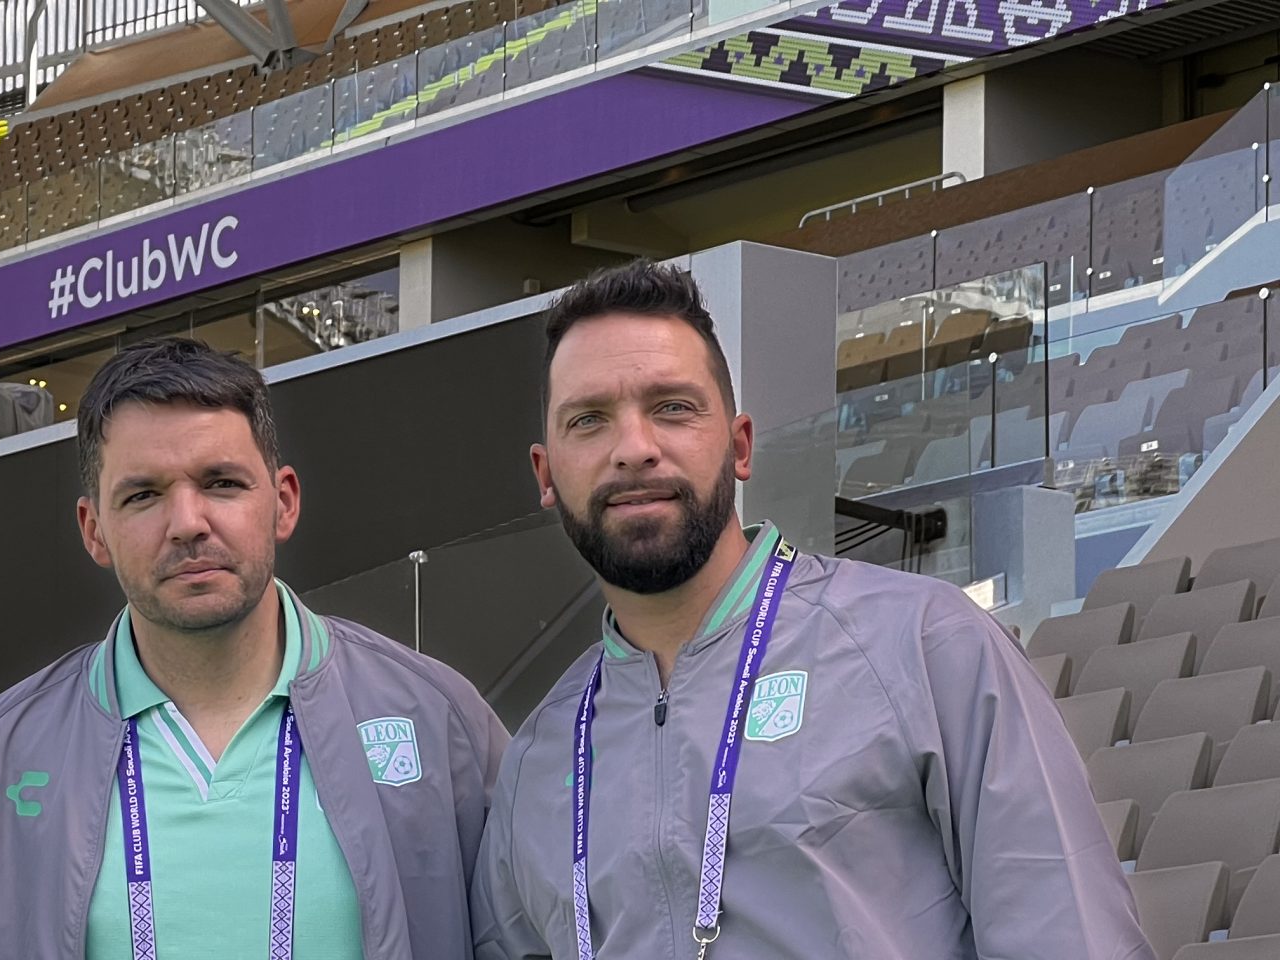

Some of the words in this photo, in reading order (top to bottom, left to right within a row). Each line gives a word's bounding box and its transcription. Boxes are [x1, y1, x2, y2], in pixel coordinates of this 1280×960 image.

[48, 216, 238, 318] #ClubWC
[771, 562, 784, 577] FIFA
[764, 578, 778, 597] CLUB
[756, 598, 771, 628] WORLD
[752, 629, 762, 646] CUP
[742, 648, 757, 678] Saudi
[733, 680, 748, 718] Arabia
[756, 677, 800, 700] LEON
[284, 715, 294, 746] Saudi
[364, 723, 408, 742] LEON
[124, 744, 135, 776] Saudi
[282, 747, 292, 784] Arabia
[126, 778, 136, 796] CUP
[128, 797, 140, 828] WORLD
[132, 829, 142, 854] CLUB
[135, 854, 144, 875] FIFA
